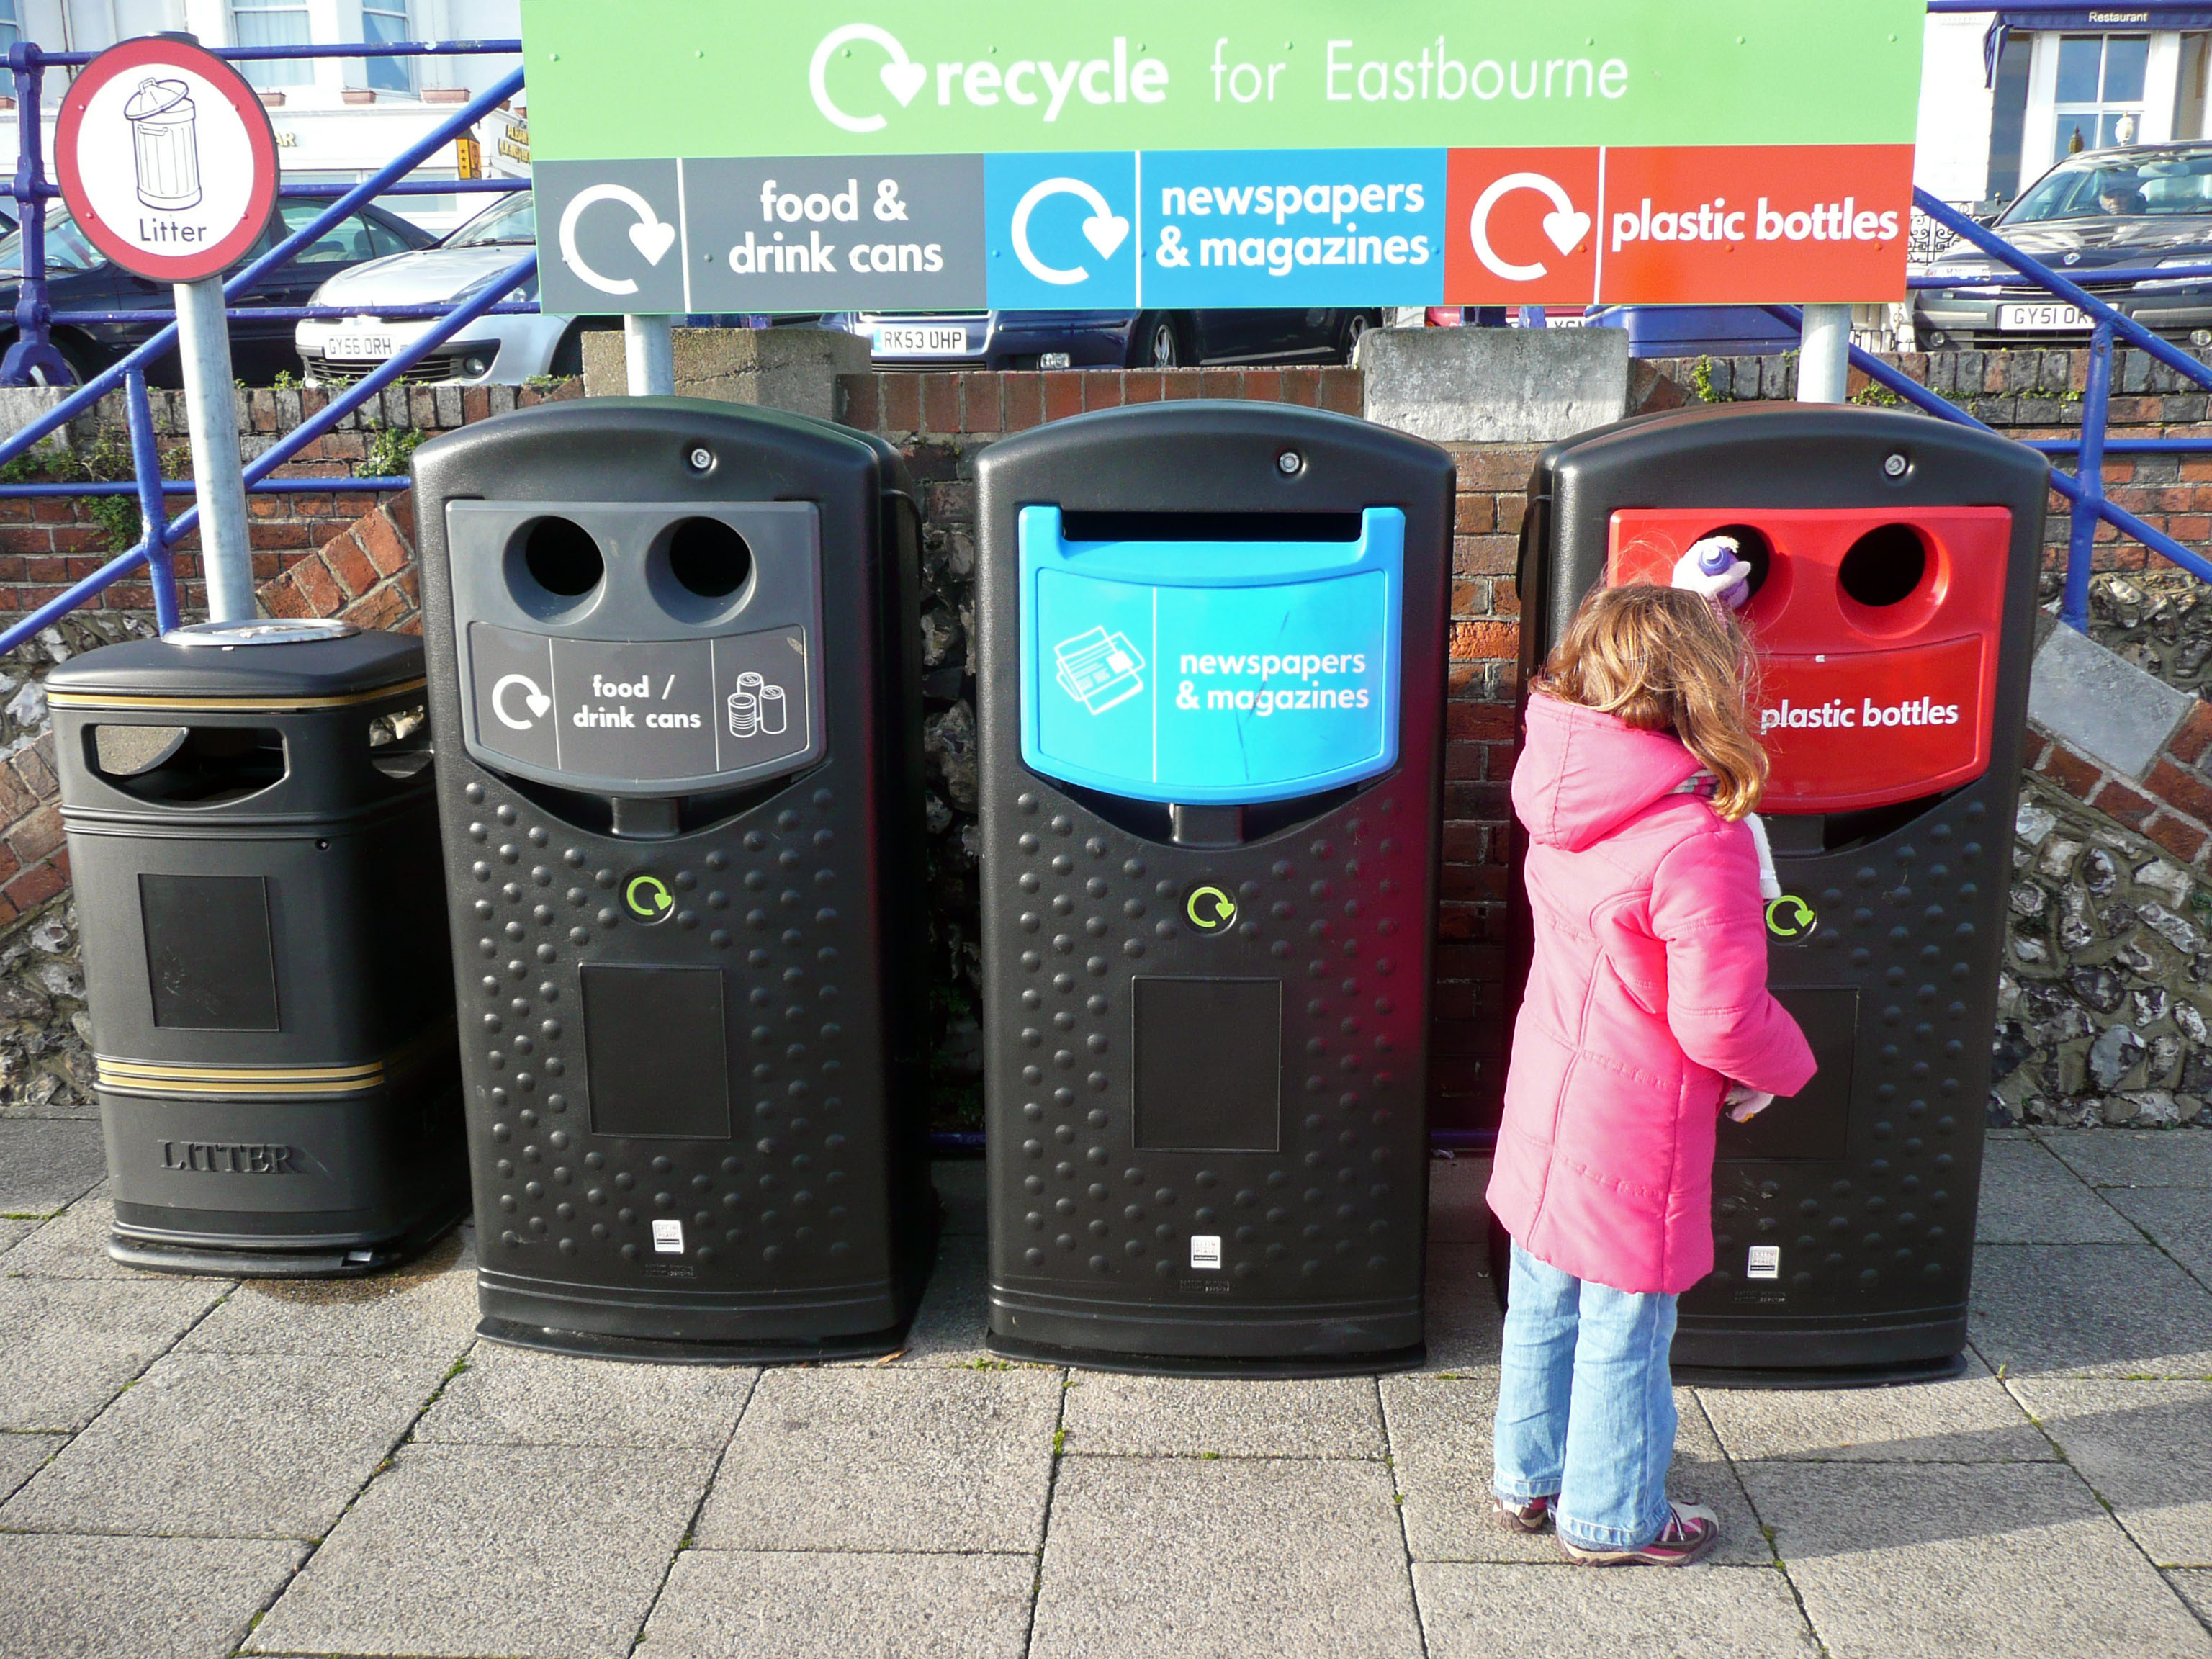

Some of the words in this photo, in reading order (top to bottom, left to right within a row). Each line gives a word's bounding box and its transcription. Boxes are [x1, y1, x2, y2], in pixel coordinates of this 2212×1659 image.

[2089, 12, 2148, 22] Restaurant
[936, 36, 1169, 122] recycle
[1210, 37, 1286, 103] for
[1326, 35, 1628, 102] Eastbourne
[760, 178, 859, 222] food
[873, 179, 909, 222] &
[1161, 183, 1425, 225] newspapers
[139, 217, 207, 243] Litter
[1611, 197, 1745, 252] plastic
[1755, 197, 1899, 240] bottles
[729, 230, 837, 274] drink
[848, 243, 944, 274] cans
[1156, 225, 1191, 268] &
[1200, 222, 1429, 276] magazines
[2014, 307, 2057, 325] GY51
[2064, 307, 2096, 325] OK
[329, 337, 361, 355] GY56
[364, 337, 392, 355] ORH
[884, 331, 925, 349] RK53
[930, 331, 962, 349] UHP
[1179, 653, 1367, 682] newspapers
[592, 674, 650, 698] food
[662, 674, 675, 700] /
[1175, 680, 1200, 710] &
[1207, 680, 1370, 717] magazines
[572, 705, 636, 729] drink
[645, 713, 702, 729] cans
[1760, 698, 1856, 735] plastic
[1862, 696, 1959, 727] bottles
[157, 1139, 297, 1174] LITTER
